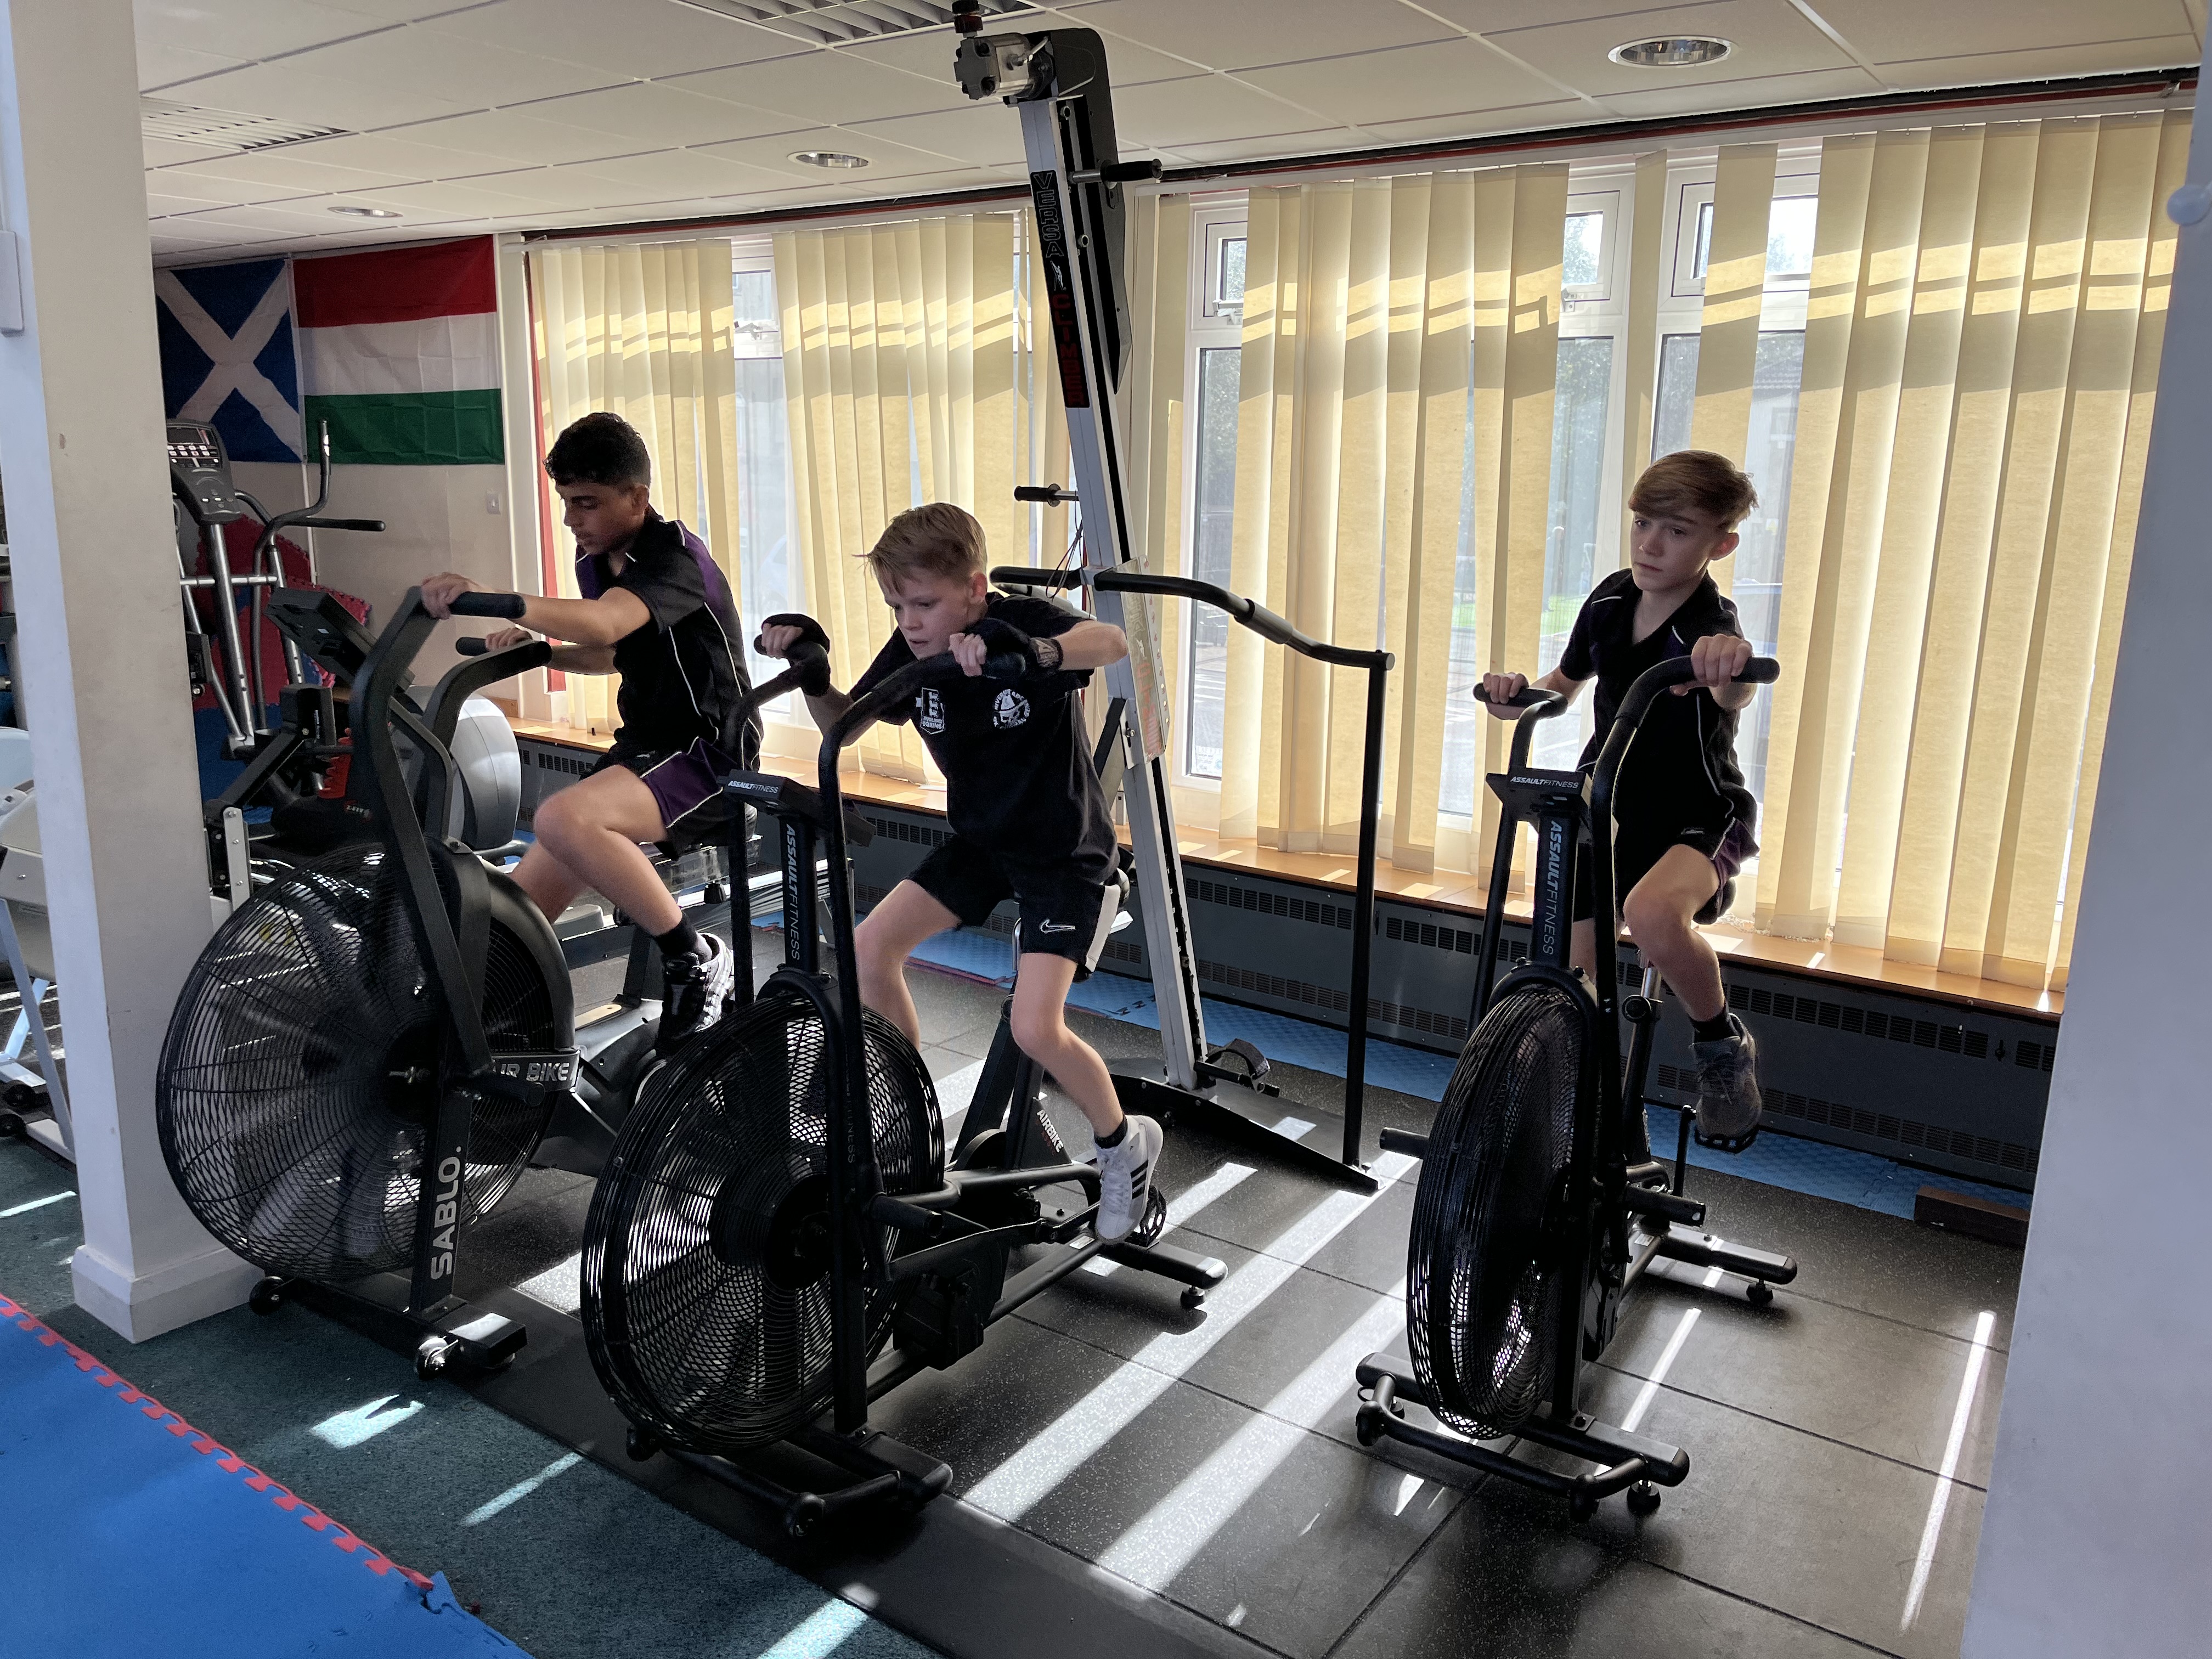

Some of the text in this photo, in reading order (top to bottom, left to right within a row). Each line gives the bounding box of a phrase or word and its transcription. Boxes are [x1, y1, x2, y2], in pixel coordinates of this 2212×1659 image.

[1033, 172, 1064, 258] VERSA
[1052, 294, 1085, 405] CLIMBER
[727, 780, 780, 794] ASSAULTFITNESS
[1510, 776, 1579, 789] ASSAULTFITNESS
[786, 823, 800, 961] ASSAULTFITNESS
[1543, 820, 1562, 955] ASSAULTFITNESS
[493, 1063, 569, 1081] IR BIKE
[1036, 1109, 1064, 1153] AIRBIKE
[430, 1146, 461, 1280] SABLO.
